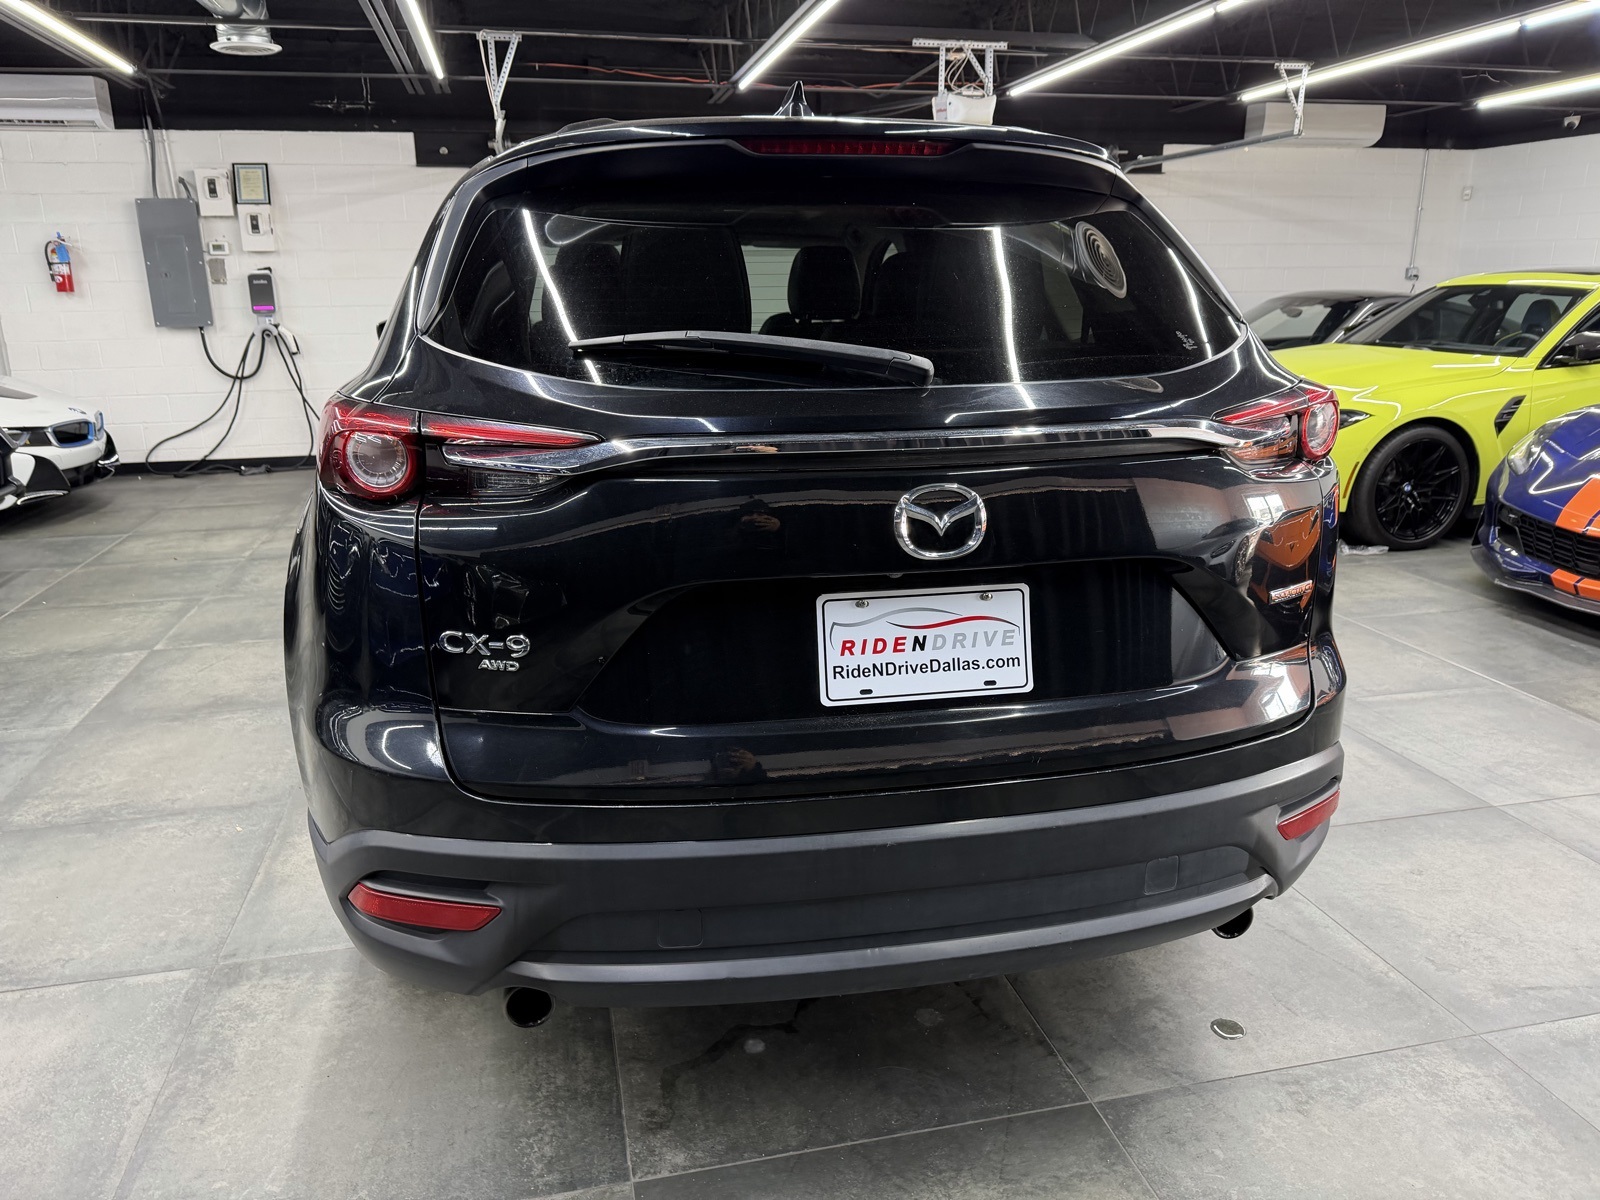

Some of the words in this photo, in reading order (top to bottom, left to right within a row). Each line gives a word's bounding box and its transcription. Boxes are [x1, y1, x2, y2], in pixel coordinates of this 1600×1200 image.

[439, 630, 531, 658] CX-9
[839, 629, 1016, 657] RIDENDRIVE
[478, 659, 520, 672] AWD
[832, 656, 1021, 680] RideNDriveDallas.com
